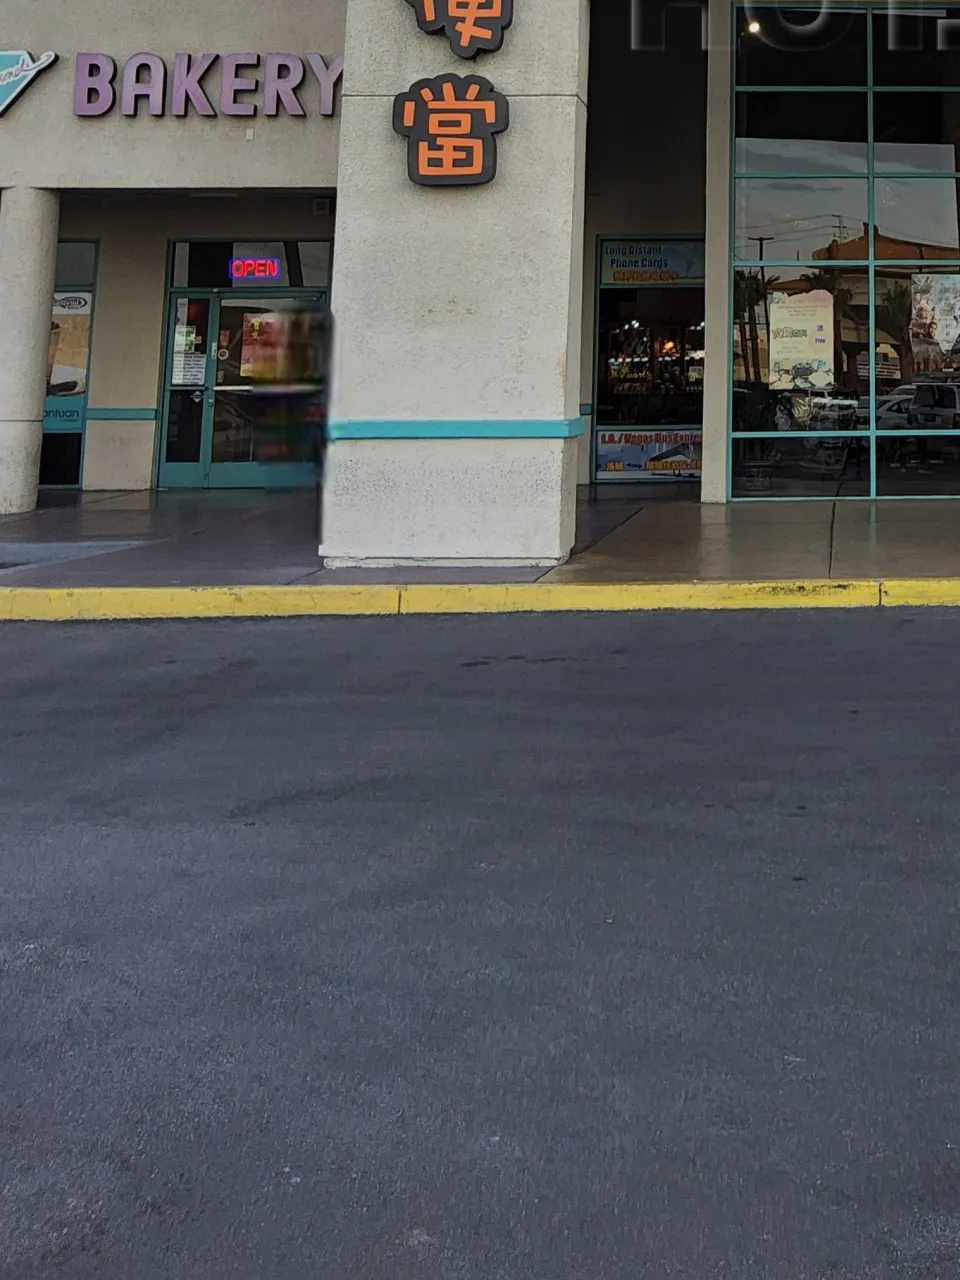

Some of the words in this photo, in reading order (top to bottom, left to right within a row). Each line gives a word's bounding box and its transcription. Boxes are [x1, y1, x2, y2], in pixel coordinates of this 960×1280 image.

[73, 51, 344, 118] BAKERY
[231, 259, 278, 277] OPEN
[610, 257, 639, 268] Phone
[641, 257, 669, 269] Cards
